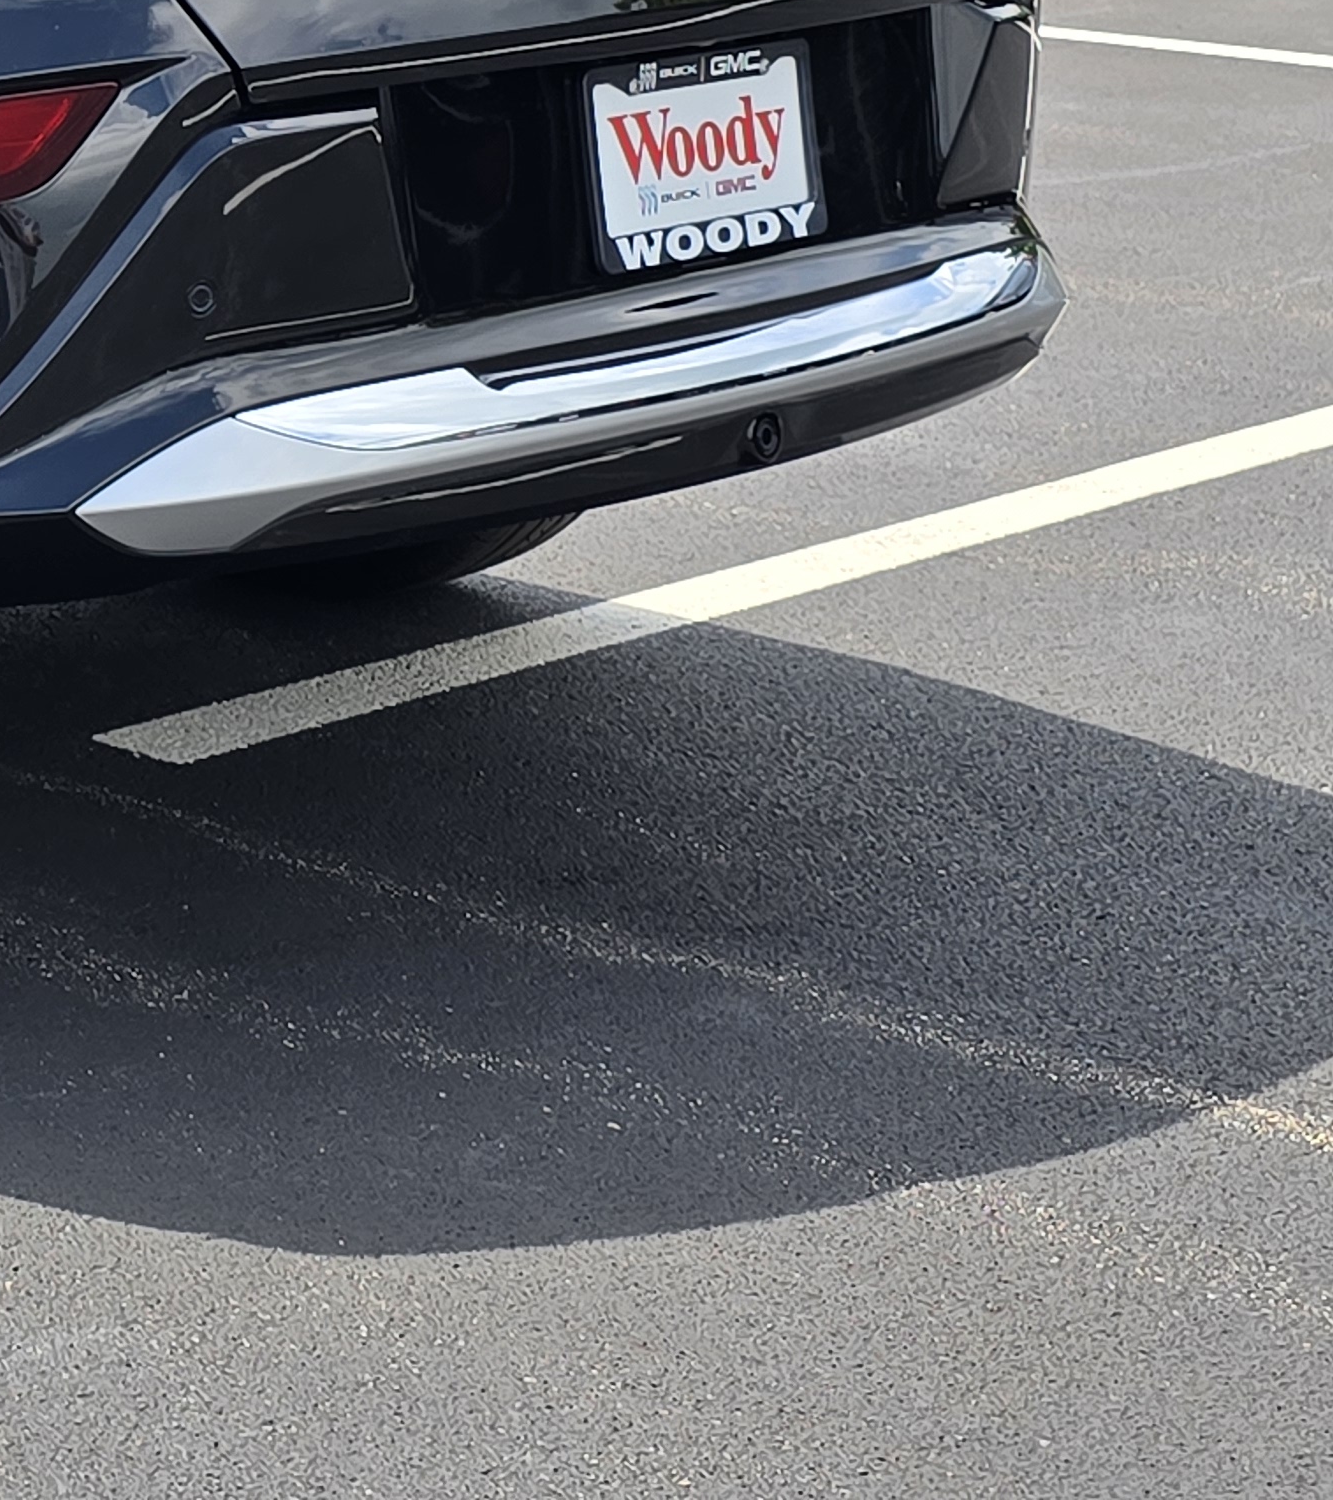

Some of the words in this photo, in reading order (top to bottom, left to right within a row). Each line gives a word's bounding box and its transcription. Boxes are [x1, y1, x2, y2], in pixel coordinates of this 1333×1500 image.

[659, 63, 698, 79] BUICK
[709, 49, 762, 77] GMC
[607, 95, 785, 185] Woody
[660, 187, 701, 203] BUICK
[715, 174, 757, 197] GMC
[615, 201, 816, 271] WOODY
